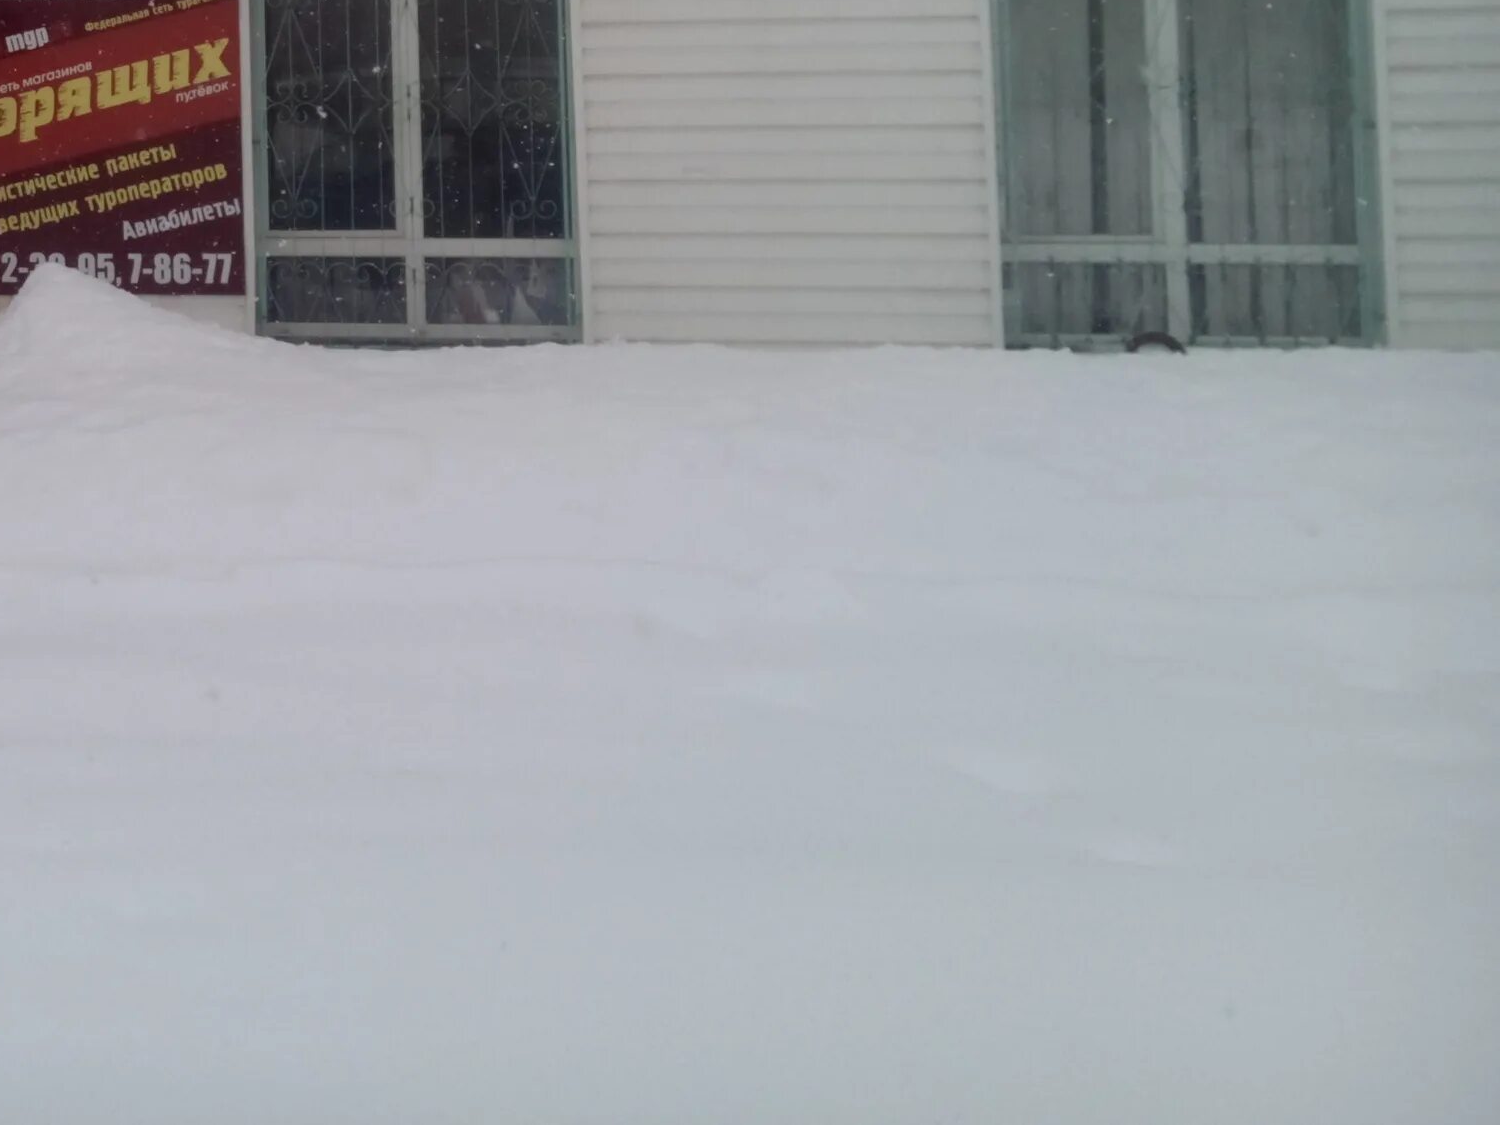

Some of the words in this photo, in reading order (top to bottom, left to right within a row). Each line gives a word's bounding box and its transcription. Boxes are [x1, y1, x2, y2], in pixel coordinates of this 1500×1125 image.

[84, 7, 150, 32] Федеральная
[152, 2, 174, 16] сеть
[22, 60, 93, 88] магазинов
[106, 143, 178, 177] пакеты
[85, 162, 228, 215] туроператоров
[122, 197, 241, 241] Авиабилеты
